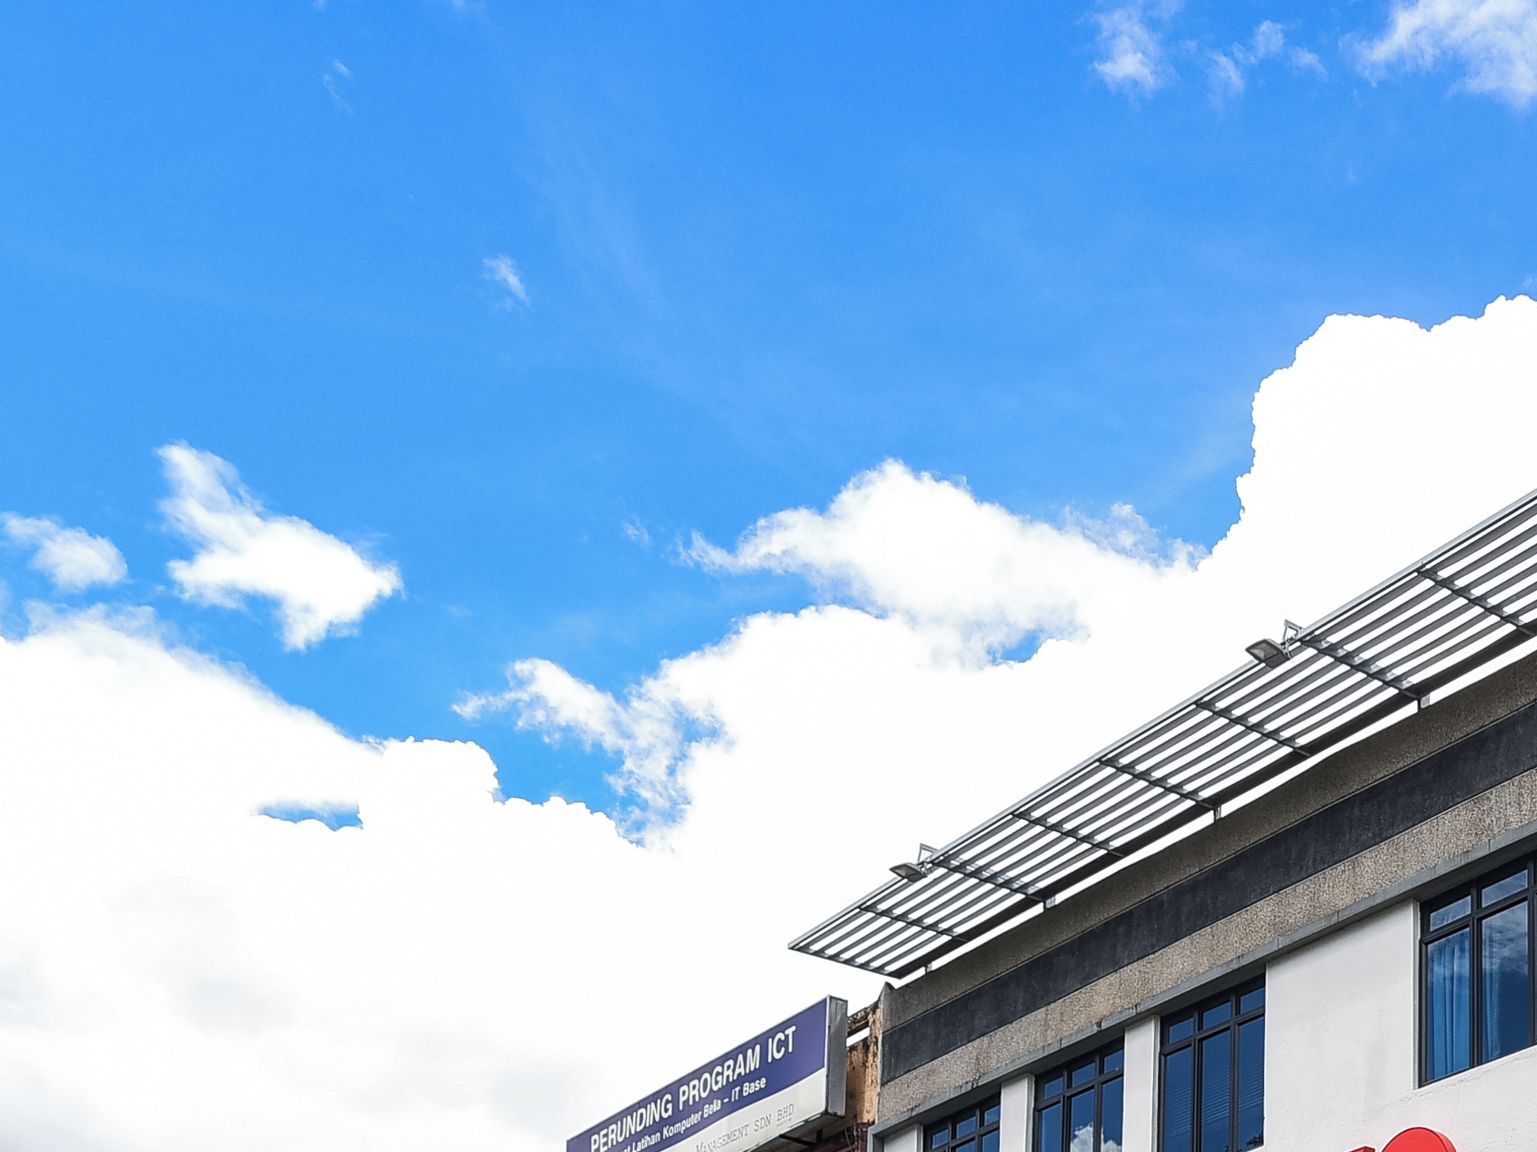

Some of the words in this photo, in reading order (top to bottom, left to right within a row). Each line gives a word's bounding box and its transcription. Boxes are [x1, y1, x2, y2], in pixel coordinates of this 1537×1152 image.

[679, 1044, 760, 1111] PROGRAM
[768, 1025, 796, 1063] ICT
[662, 1110, 702, 1139] Komputer
[731, 1086, 741, 1102] IT
[742, 1077, 766, 1097] Base
[753, 1113, 772, 1132] SDN
[777, 1103, 795, 1121] BHD
